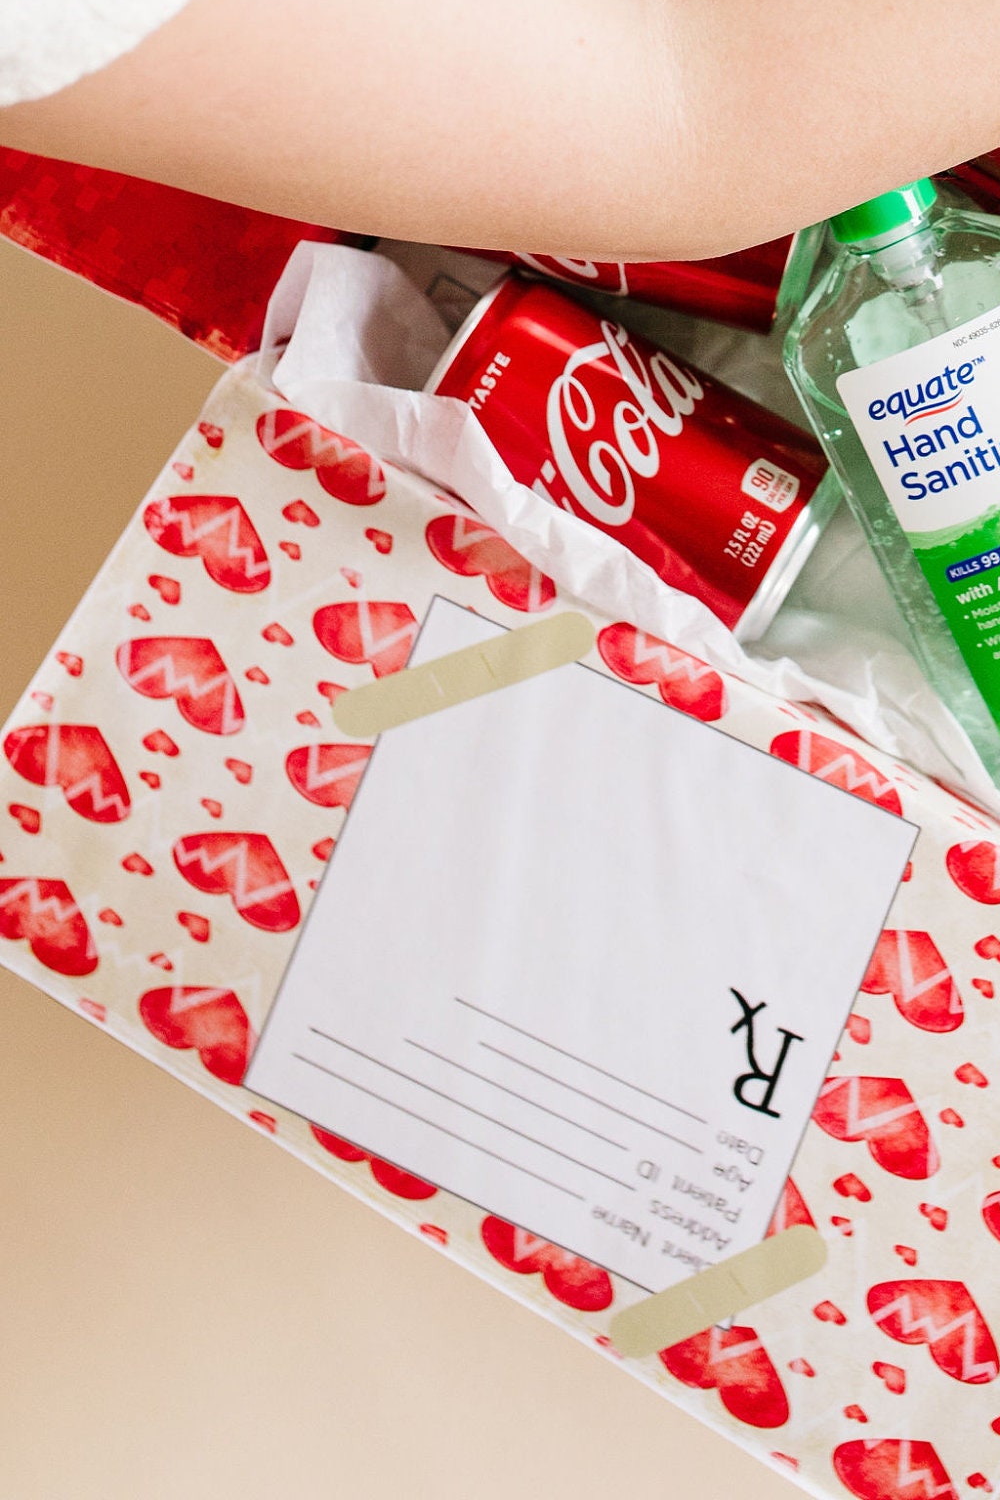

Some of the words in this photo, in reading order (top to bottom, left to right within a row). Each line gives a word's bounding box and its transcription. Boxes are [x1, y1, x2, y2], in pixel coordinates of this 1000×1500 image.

[952, 335, 968, 348] NDC
[466, 350, 512, 412] TASTE
[882, 405, 983, 469] Hand
[749, 465, 776, 492] 90
[731, 525, 752, 544] FL
[738, 509, 761, 531] OZ
[722, 537, 744, 559] 7.5
[737, 539, 765, 569] (222
[751, 517, 778, 545] mL)
[948, 559, 980, 578] KILLS
[954, 580, 994, 606] with
[712, 1128, 765, 1166] Date
[634, 1157, 662, 1182] ID
[709, 1158, 754, 1194] Age
[667, 1175, 743, 1224] Patient
[586, 1204, 652, 1247] Name
[644, 1198, 732, 1252] Address
